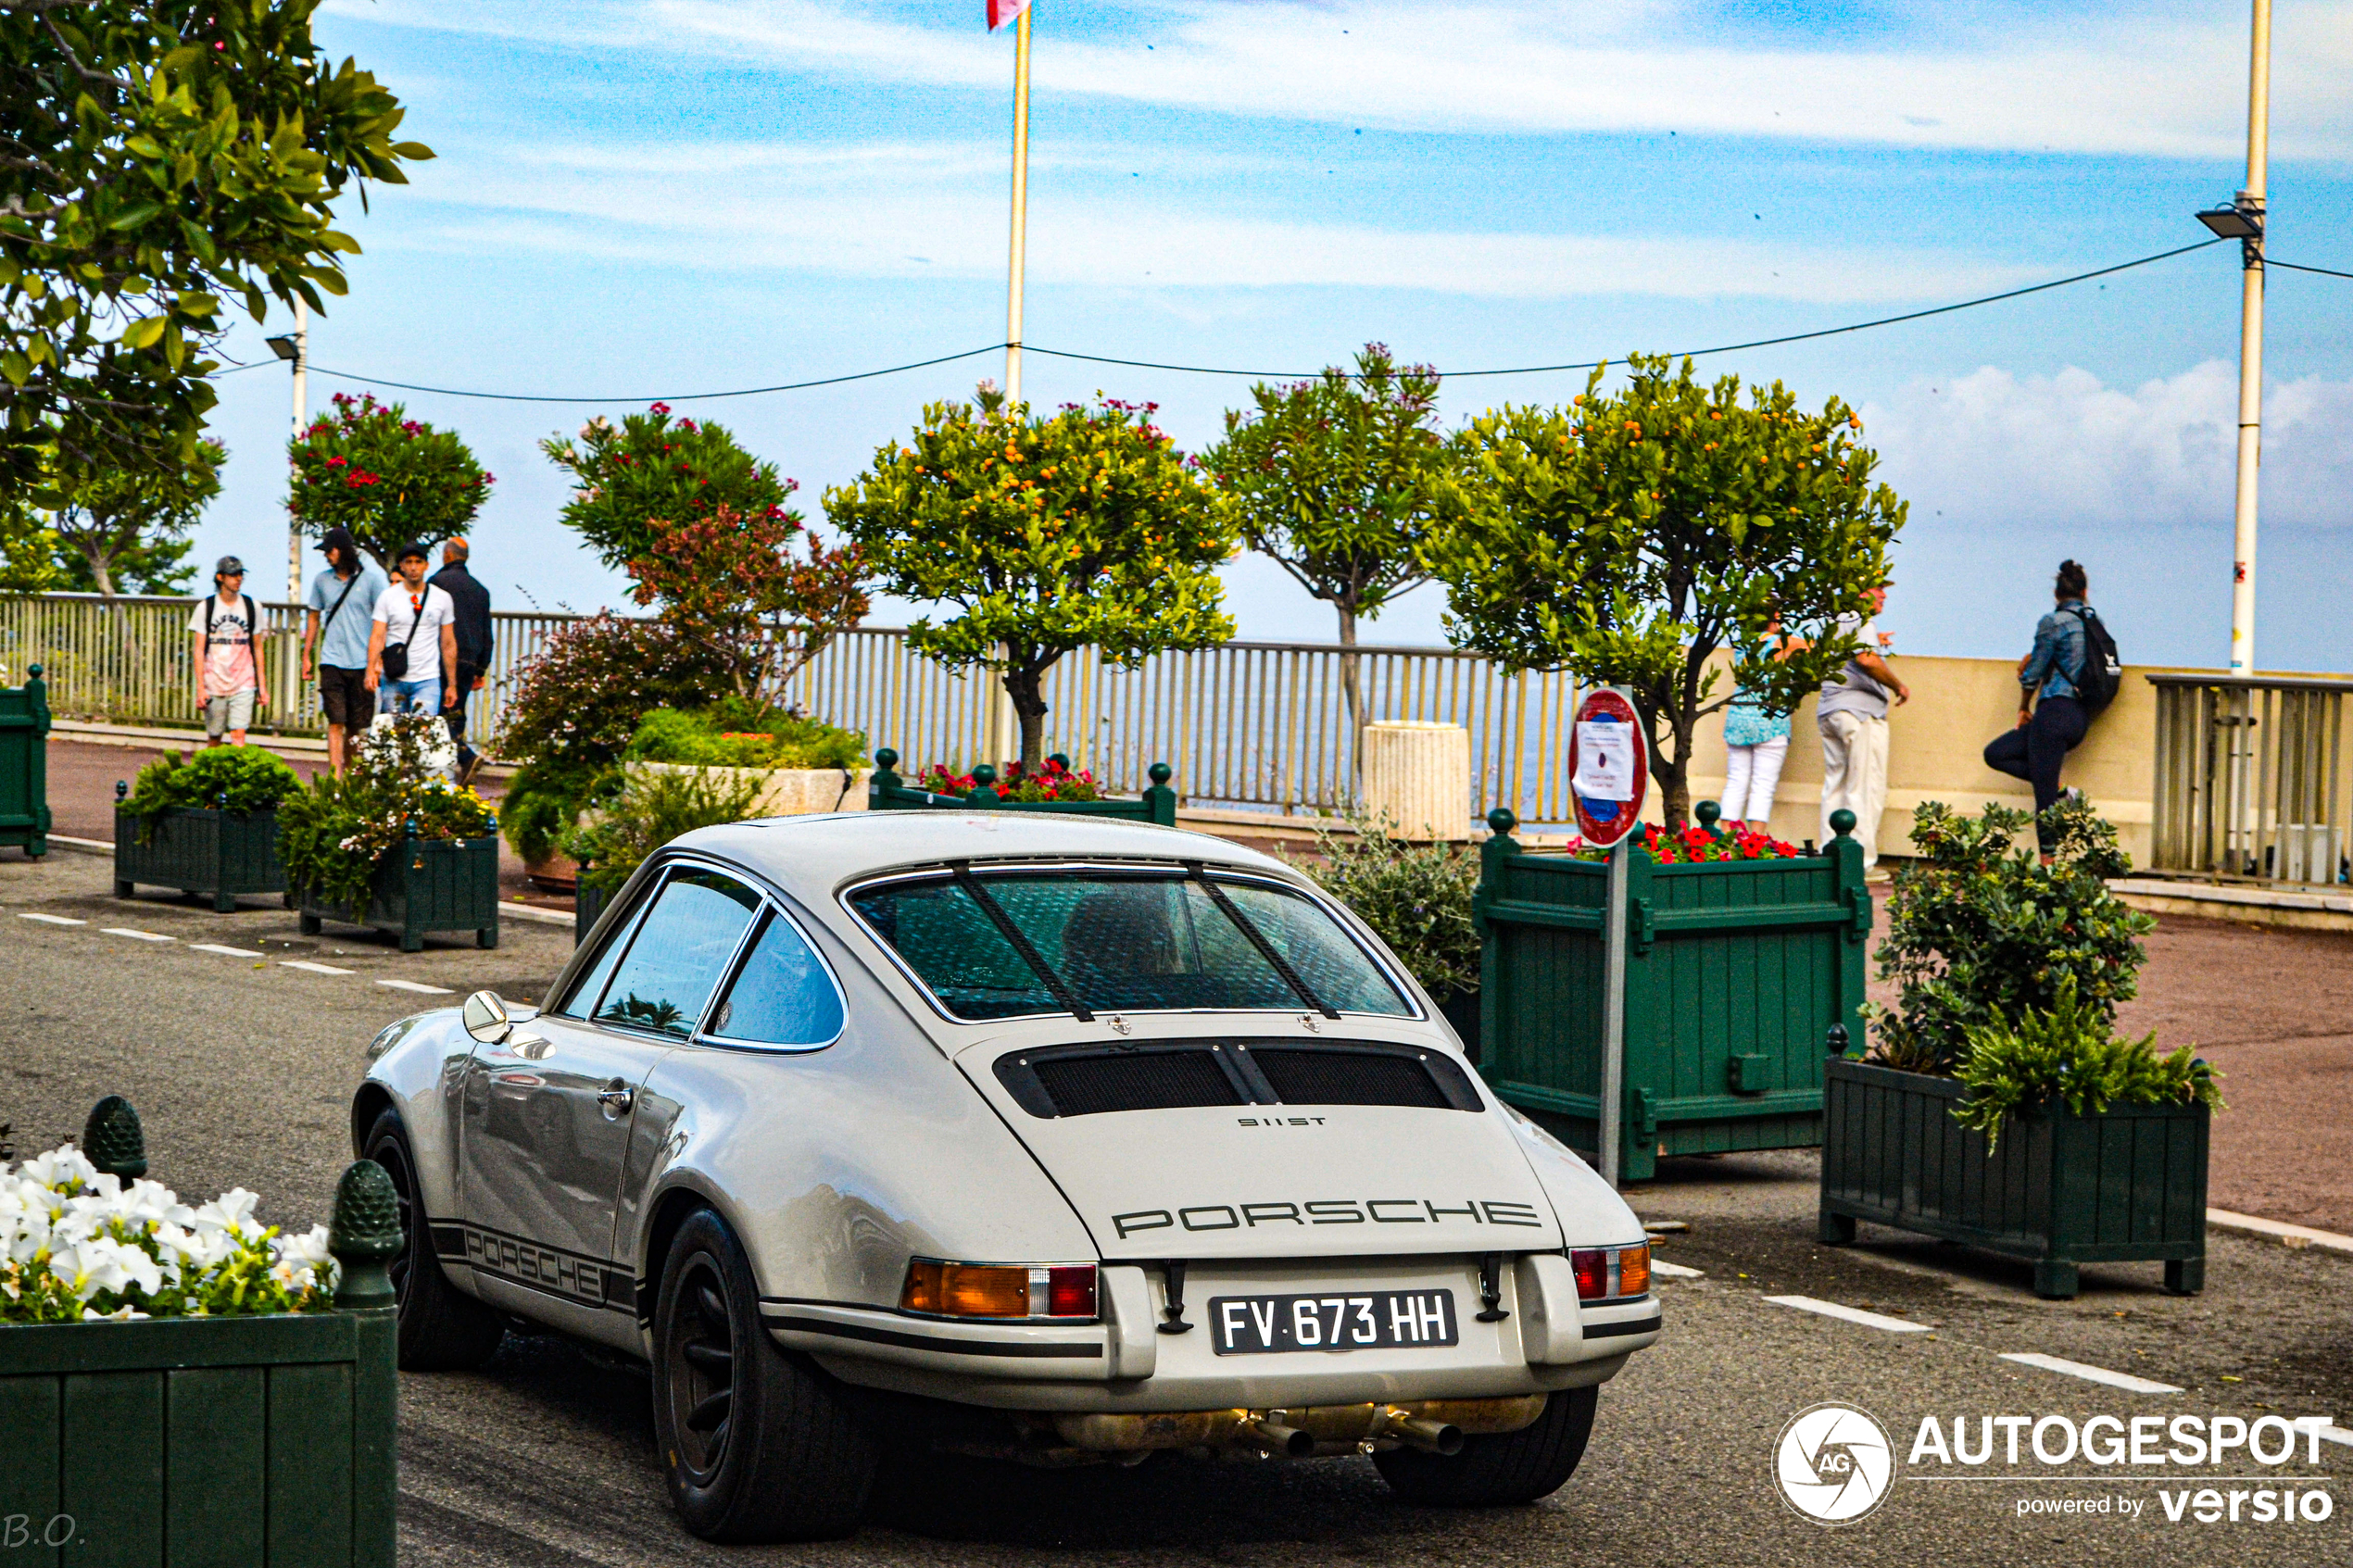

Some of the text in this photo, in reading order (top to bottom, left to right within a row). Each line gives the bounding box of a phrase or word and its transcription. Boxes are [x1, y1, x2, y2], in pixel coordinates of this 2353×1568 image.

[1111, 1199, 1542, 1240] PORSCHE
[466, 1229, 600, 1298] PORSCHE
[1222, 1295, 1447, 1348] FV 673 HH
